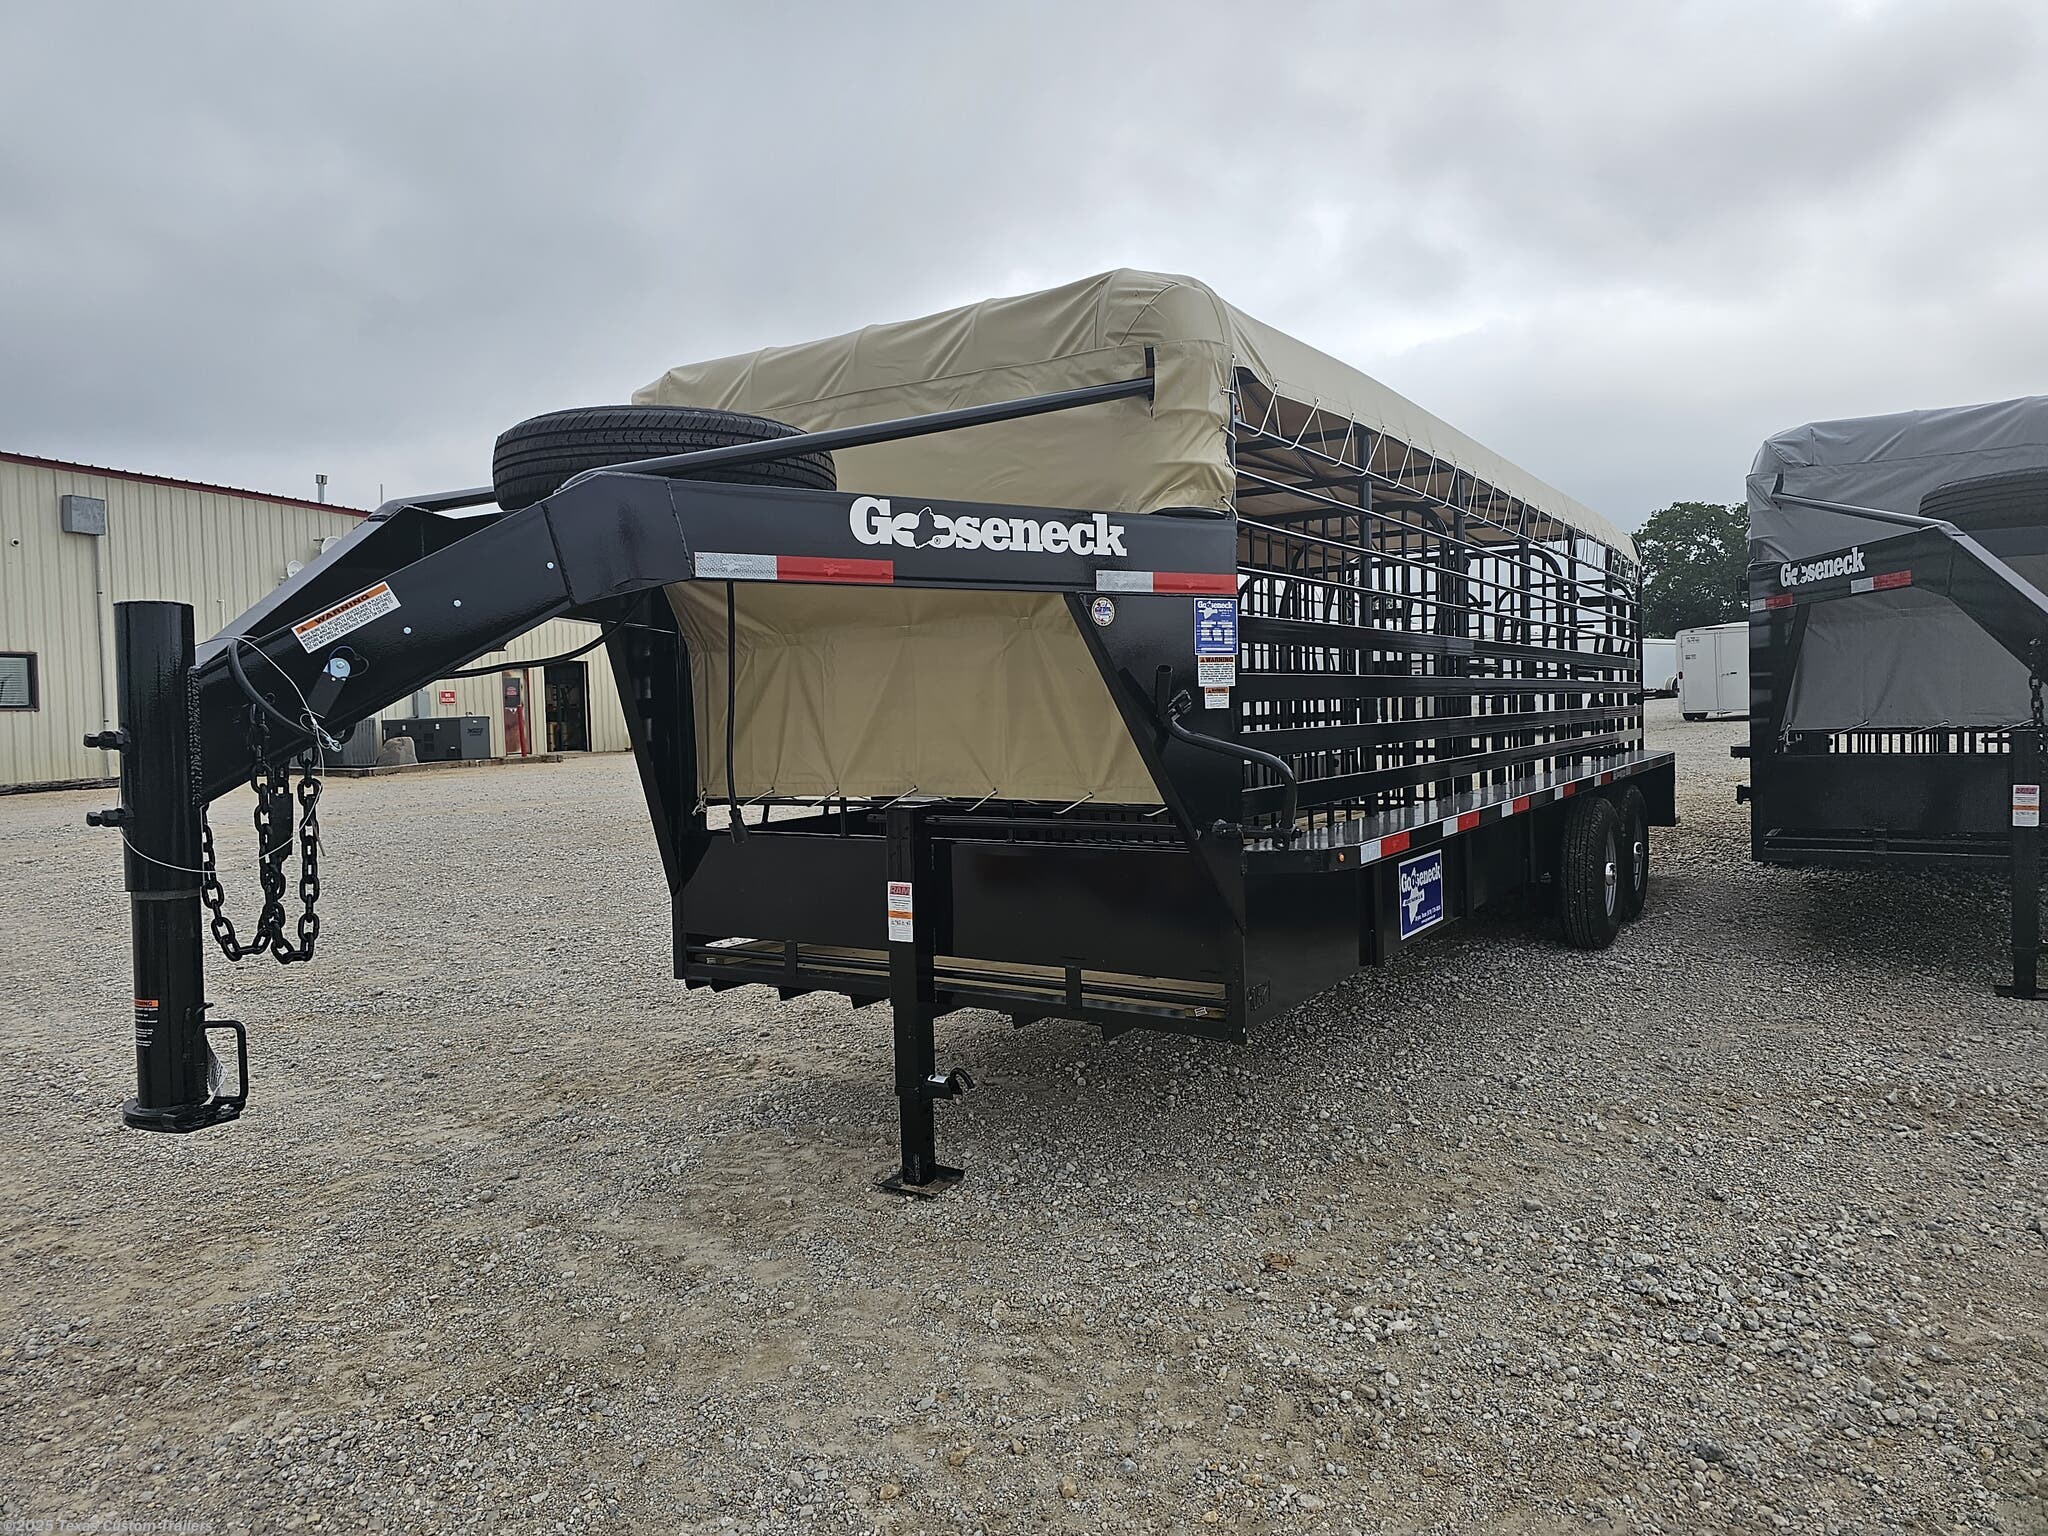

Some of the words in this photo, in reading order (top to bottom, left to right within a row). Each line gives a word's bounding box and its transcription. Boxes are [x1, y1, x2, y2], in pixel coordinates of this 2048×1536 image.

[850, 496, 1127, 557] Gooseneck
[1780, 546, 1865, 588] Gooseneck
[313, 593, 370, 624] WARNING
[1197, 600, 1233, 609] Gooseneck
[1401, 862, 1441, 893] Gooseneck
